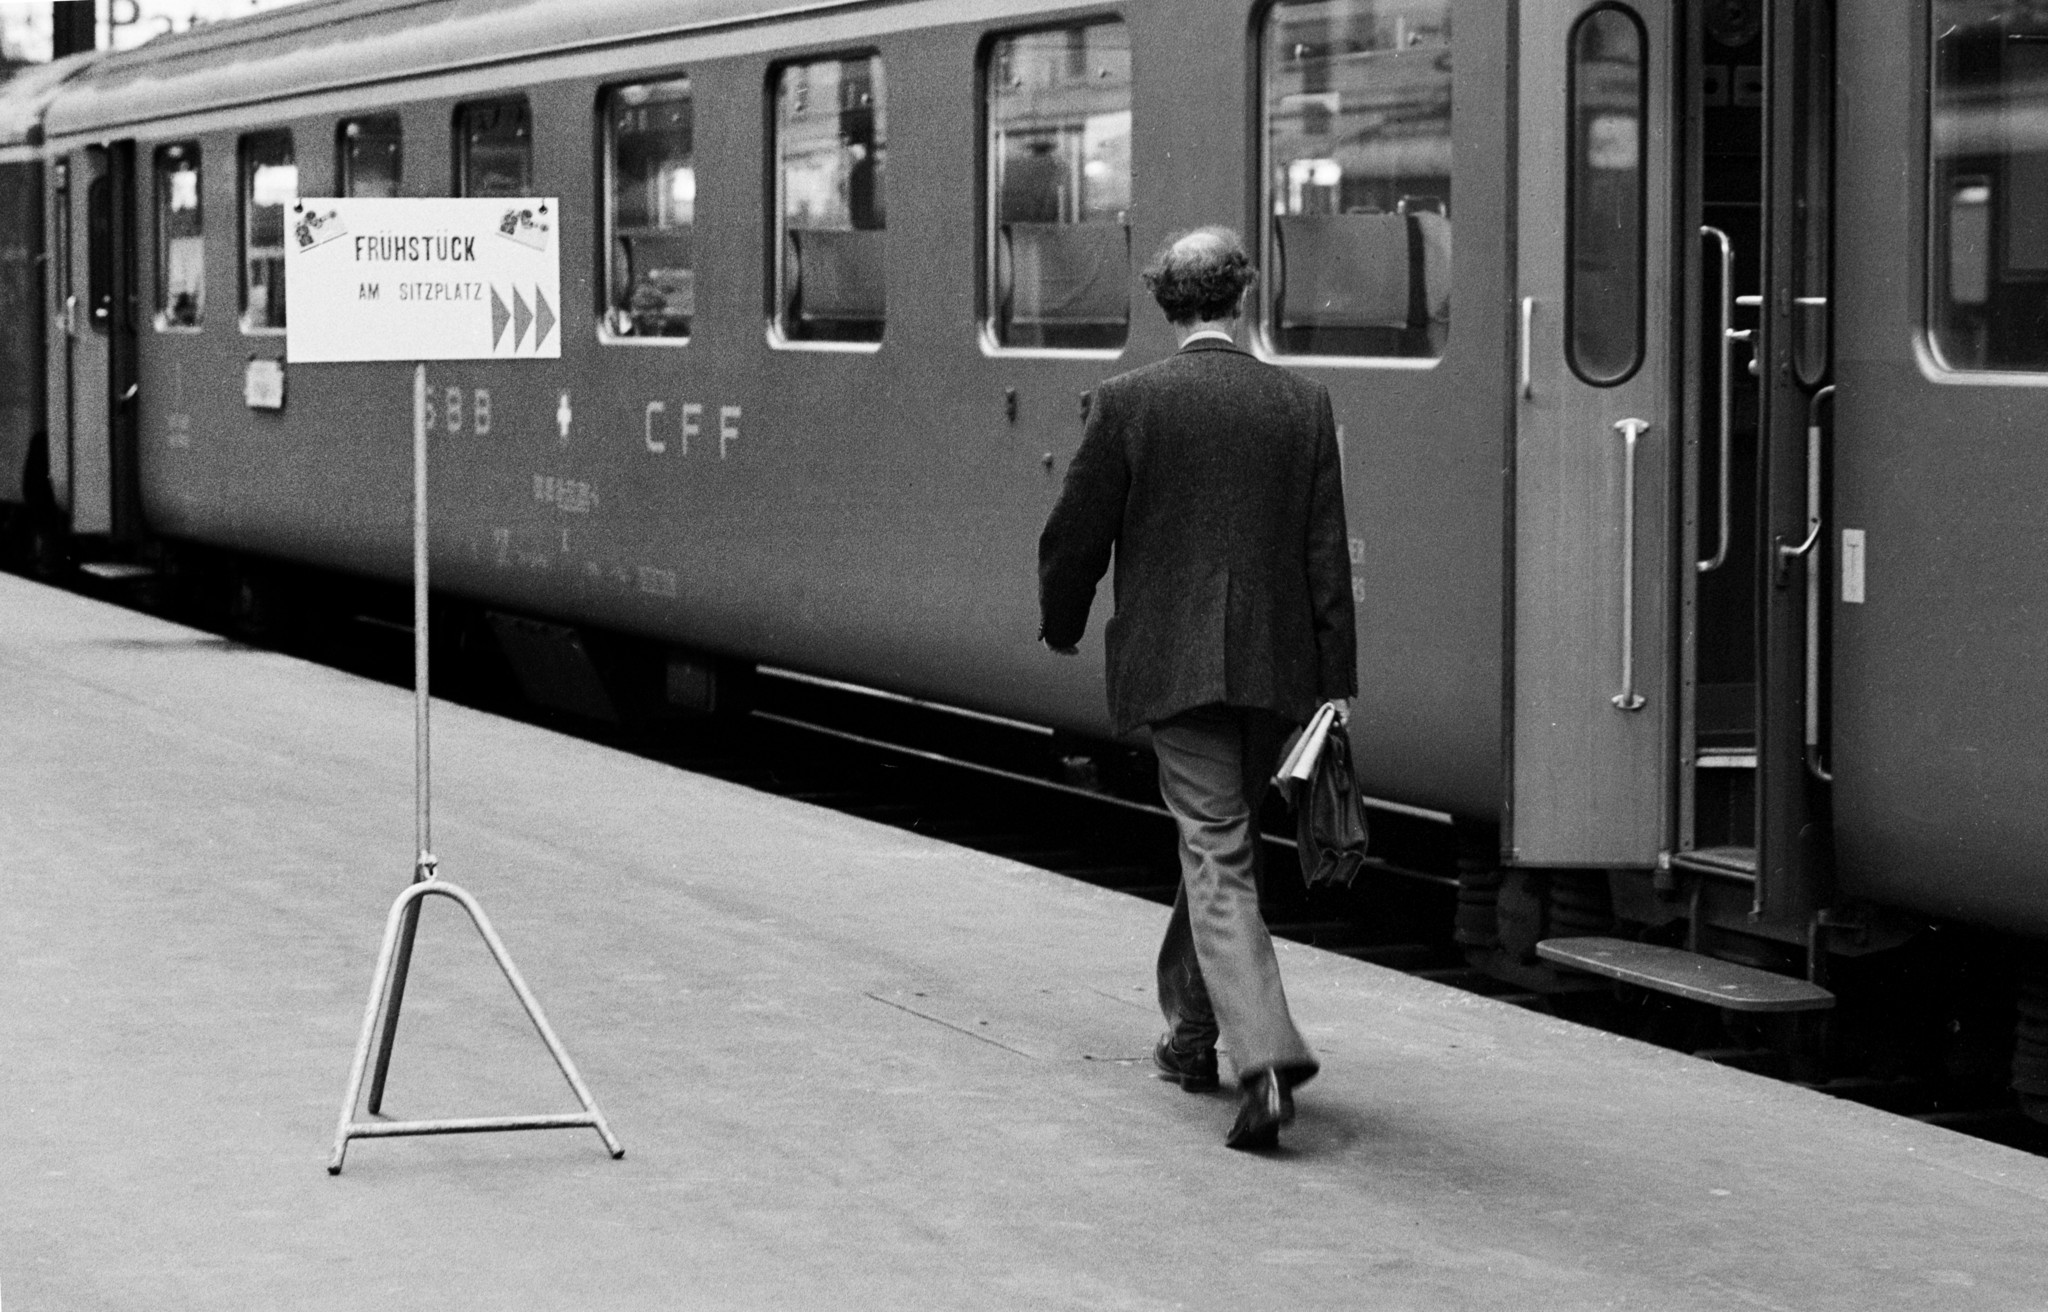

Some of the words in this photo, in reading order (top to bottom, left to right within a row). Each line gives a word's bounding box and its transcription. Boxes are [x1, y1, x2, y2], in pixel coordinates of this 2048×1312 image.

[355, 229, 476, 262] FRÜHSTÜCK
[358, 283, 380, 300] AM
[399, 283, 483, 301] SITZPLATZ
[646, 400, 742, 459] CFF
